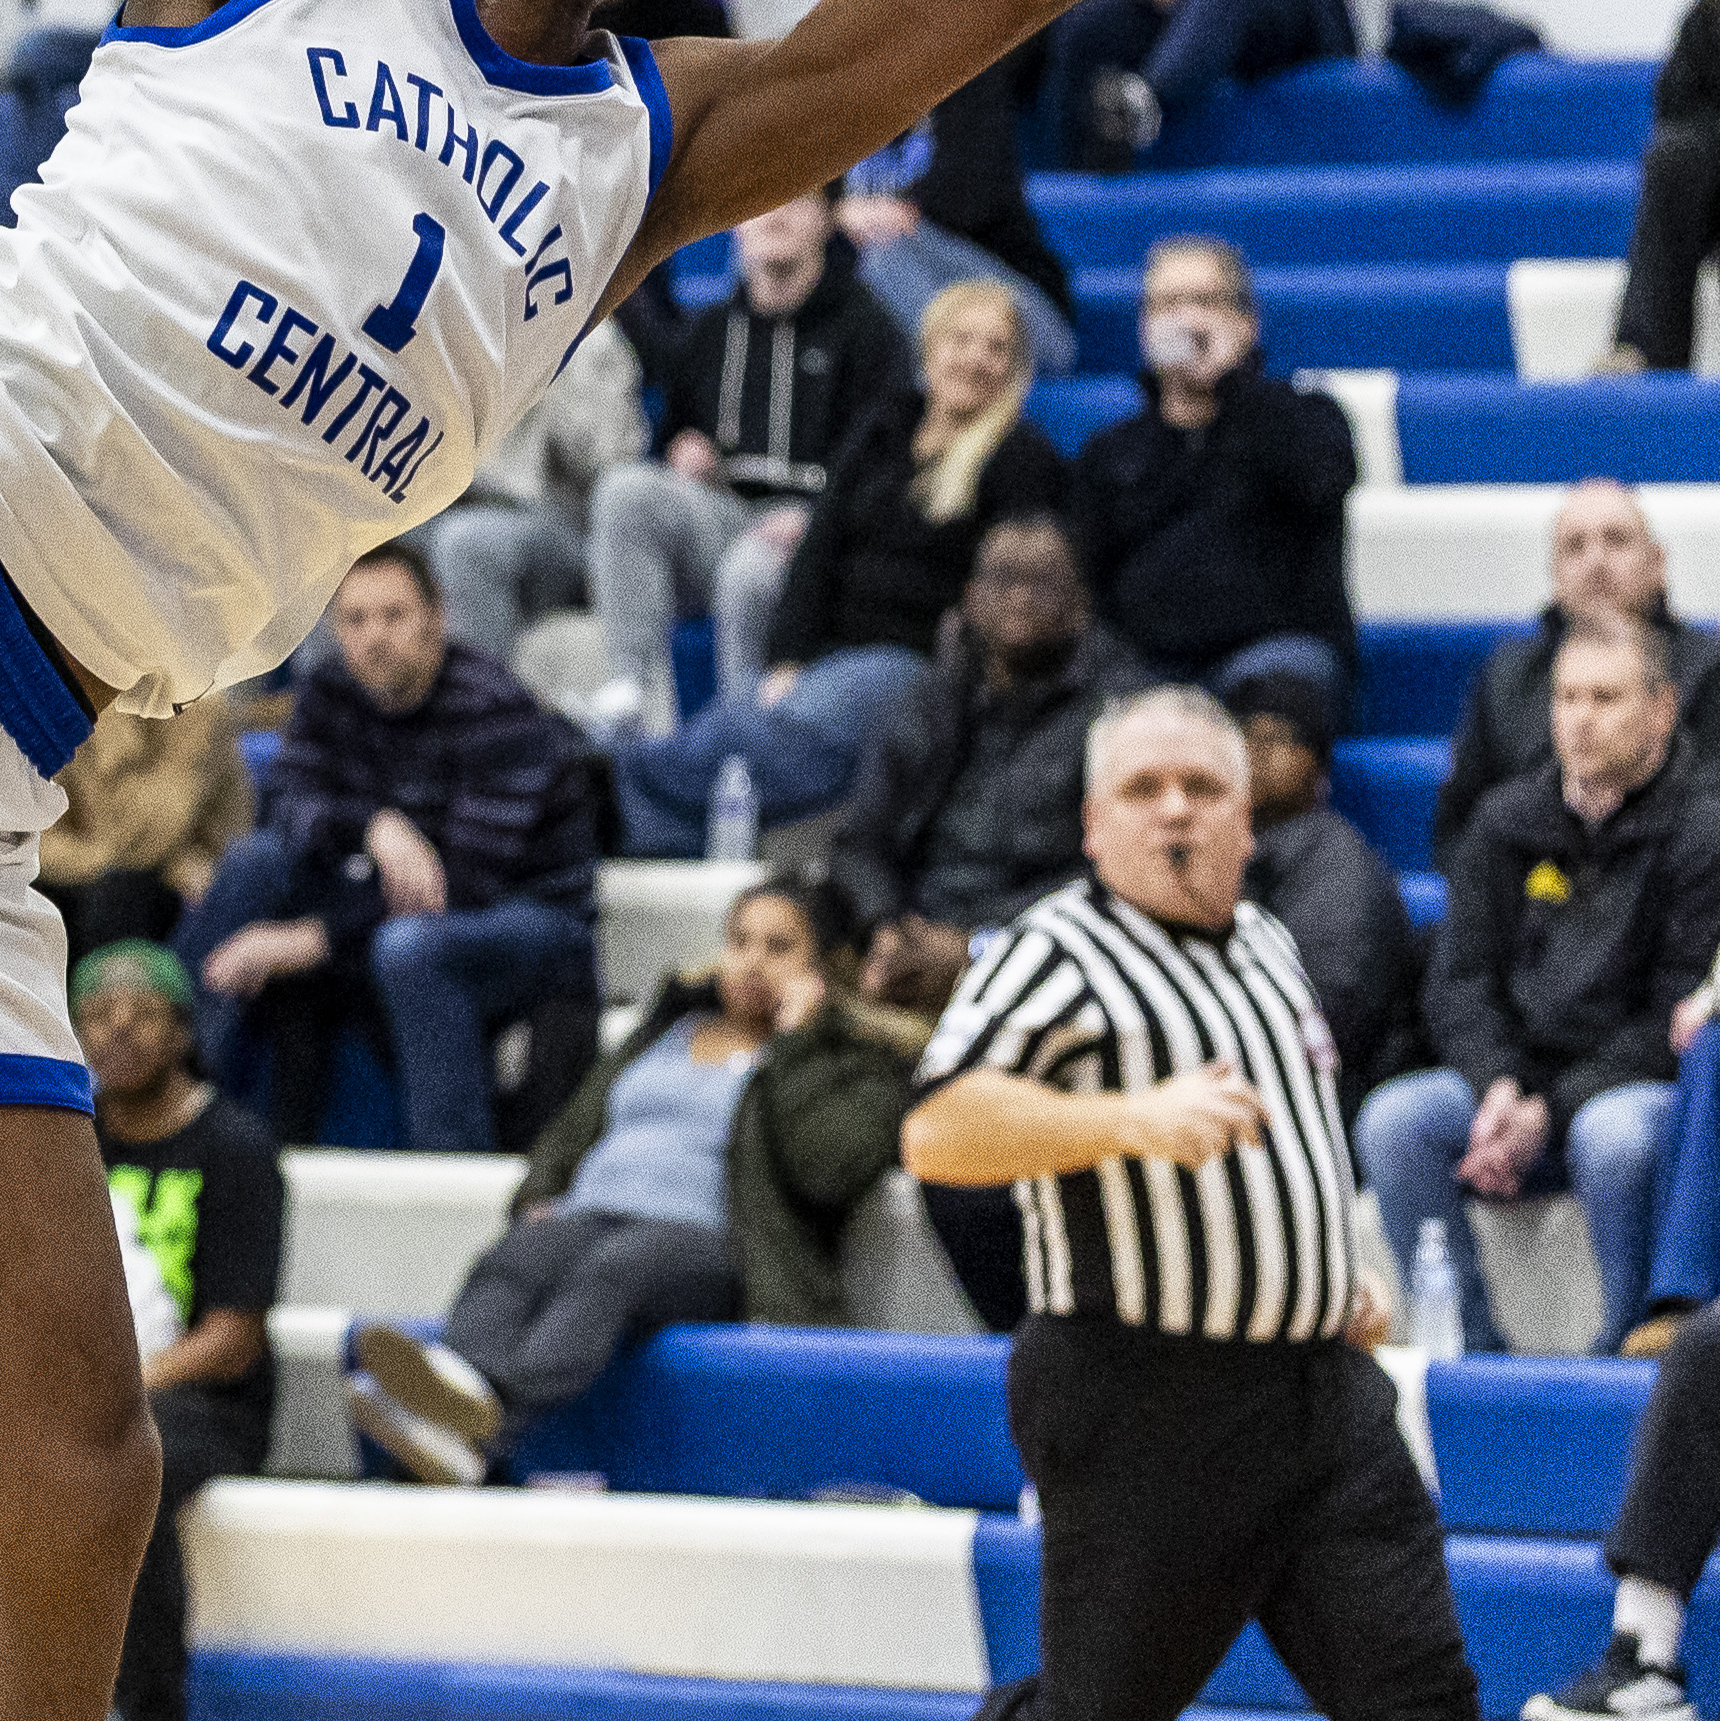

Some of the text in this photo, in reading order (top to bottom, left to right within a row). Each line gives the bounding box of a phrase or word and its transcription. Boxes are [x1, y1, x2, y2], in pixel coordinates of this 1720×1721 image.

[306, 47, 573, 322] CATHOLIC
[361, 212, 446, 354] 1
[206, 280, 444, 504] CENTRAL
